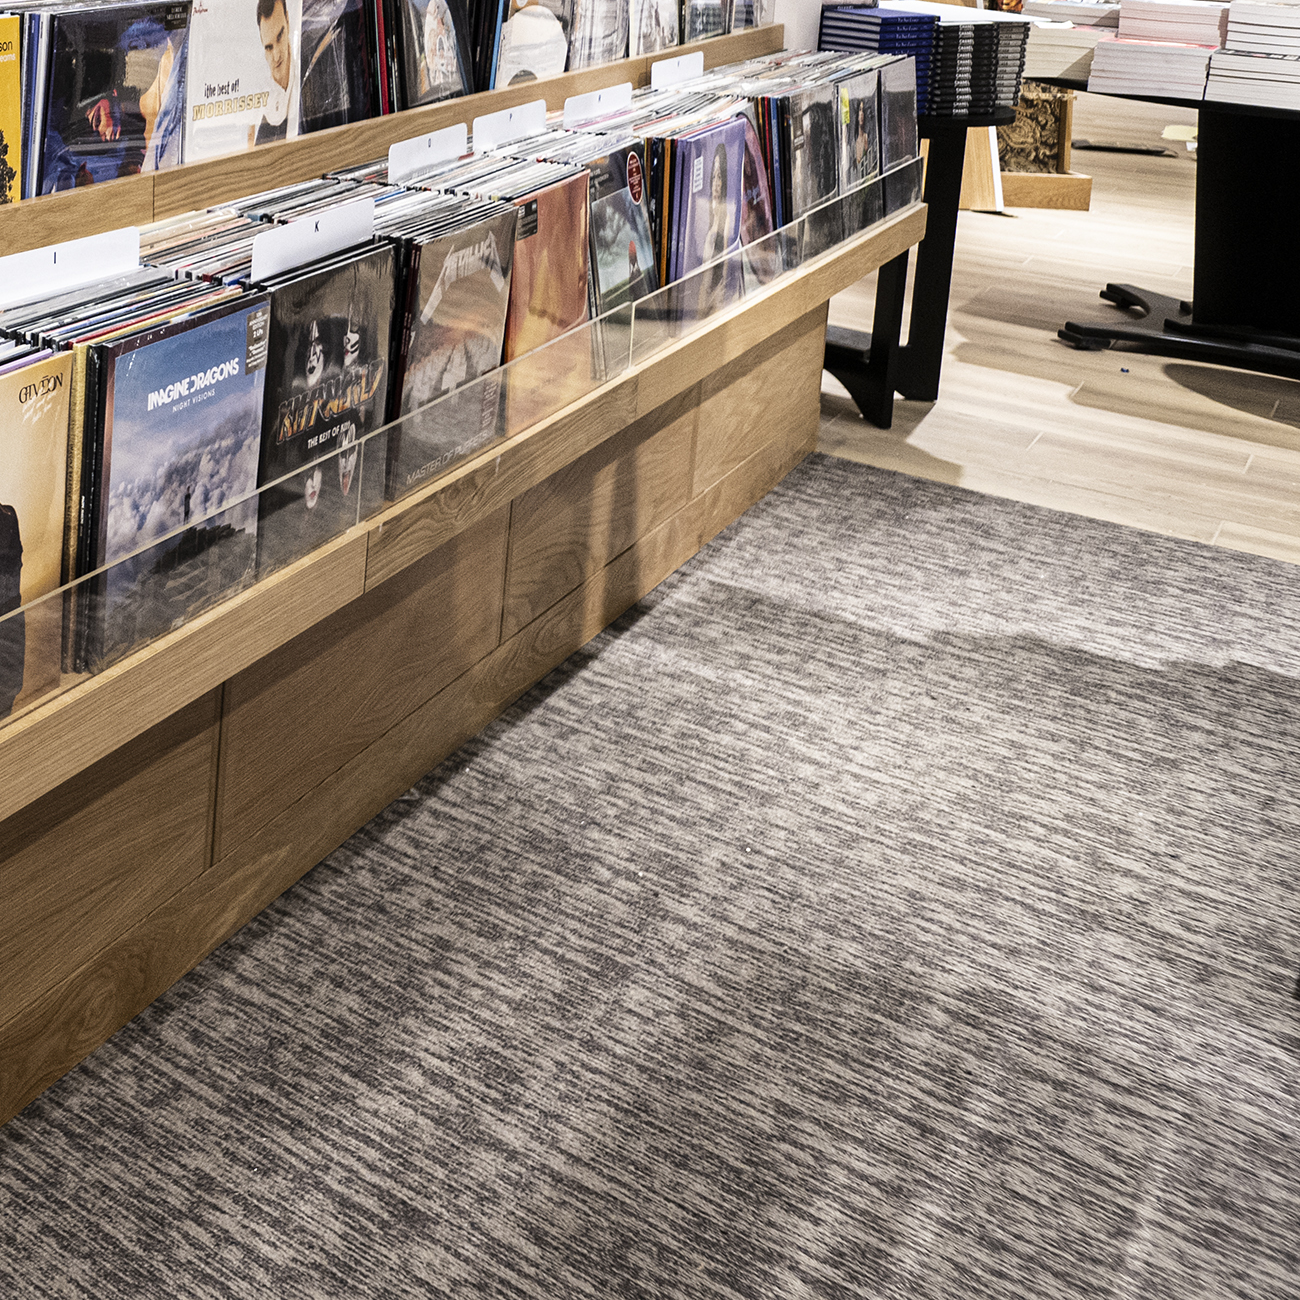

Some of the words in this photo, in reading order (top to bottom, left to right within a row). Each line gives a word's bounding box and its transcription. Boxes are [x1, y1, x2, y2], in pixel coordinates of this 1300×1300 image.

[217, 80, 230, 97] best
[192, 90, 270, 122] MORRISSEY
[314, 220, 321, 234] K
[53, 251, 57, 265] I
[147, 377, 190, 411] IMAGINE
[190, 357, 240, 392] DRAGONS
[172, 399, 191, 413] NIGHT
[192, 388, 216, 405] VISIONS
[307, 434, 318, 450] THE
[319, 428, 332, 446] BEST
[332, 425, 340, 440] OF
[406, 458, 442, 486] MASTER
[442, 451, 453, 464] OF
[453, 431, 489, 460] PUPPETS
